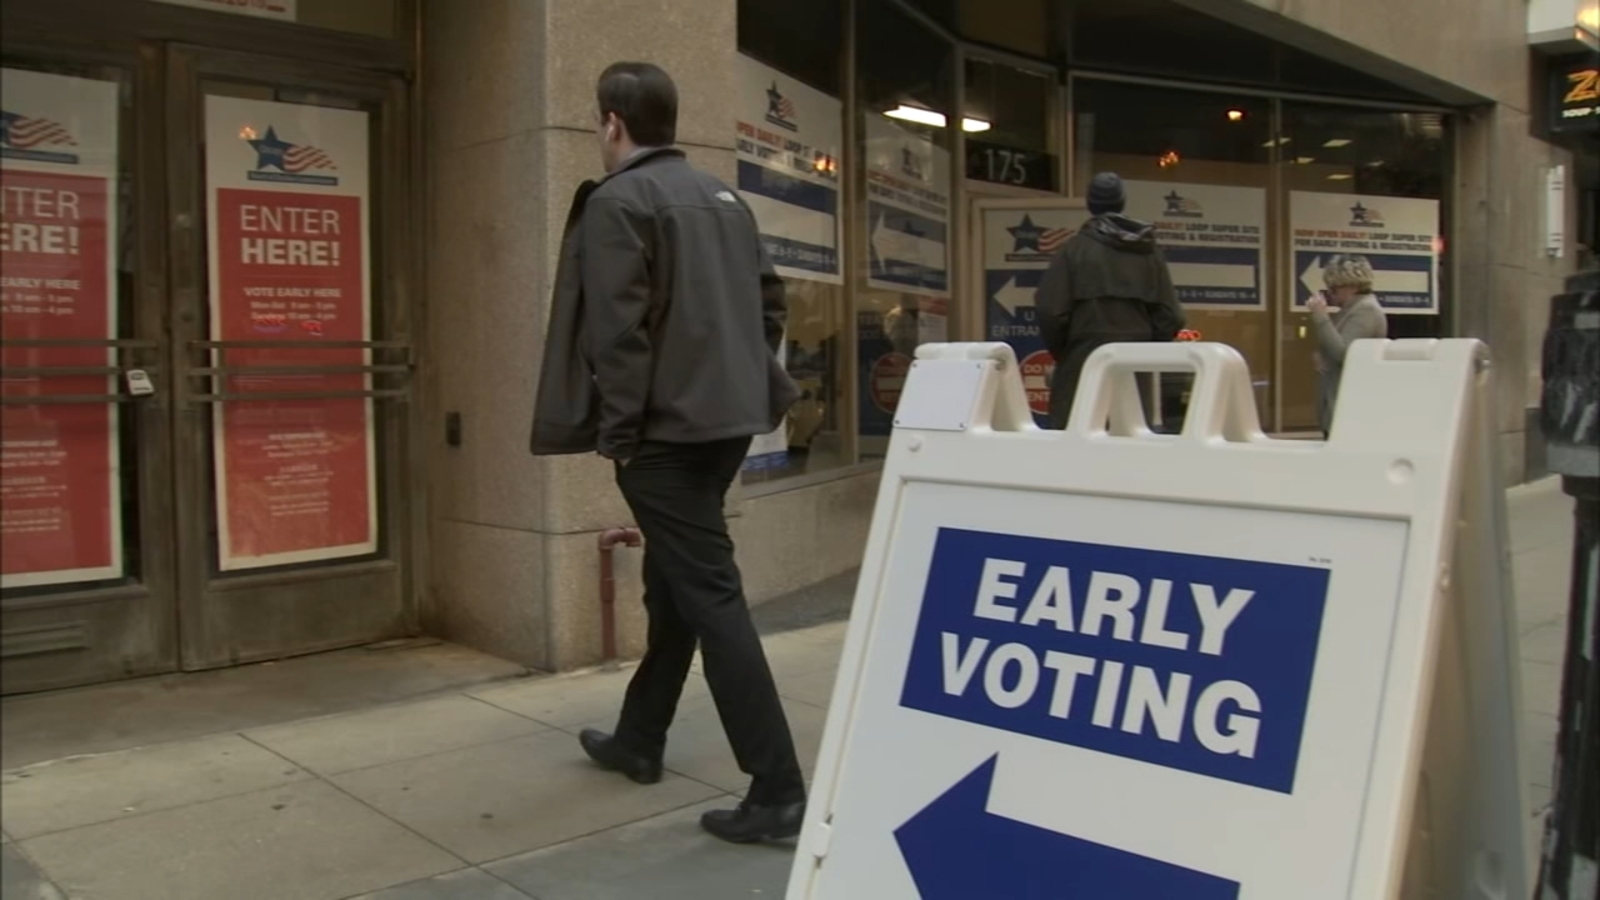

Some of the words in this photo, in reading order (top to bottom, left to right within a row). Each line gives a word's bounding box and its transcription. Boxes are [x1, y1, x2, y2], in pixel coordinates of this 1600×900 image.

[986, 149, 1026, 184] 175
[239, 204, 341, 235] ENTER
[1186, 223, 1209, 232] LOOP
[1212, 224, 1240, 233] SUPER
[1199, 233, 1260, 243] REGISTRATION
[1369, 233, 1389, 241] LOOP
[1391, 234, 1416, 242] SUPER
[1294, 239, 1310, 247] FOR
[1340, 241, 1370, 249] VOTING
[240, 237, 340, 267] HERE!
[45, 279, 81, 290] HERE
[243, 287, 274, 297] VOTE
[277, 288, 311, 297] EARLY
[313, 288, 342, 298] HERE
[1024, 364, 1043, 374] DO
[972, 557, 1256, 656] EARLY
[941, 631, 1262, 759] VOTING
